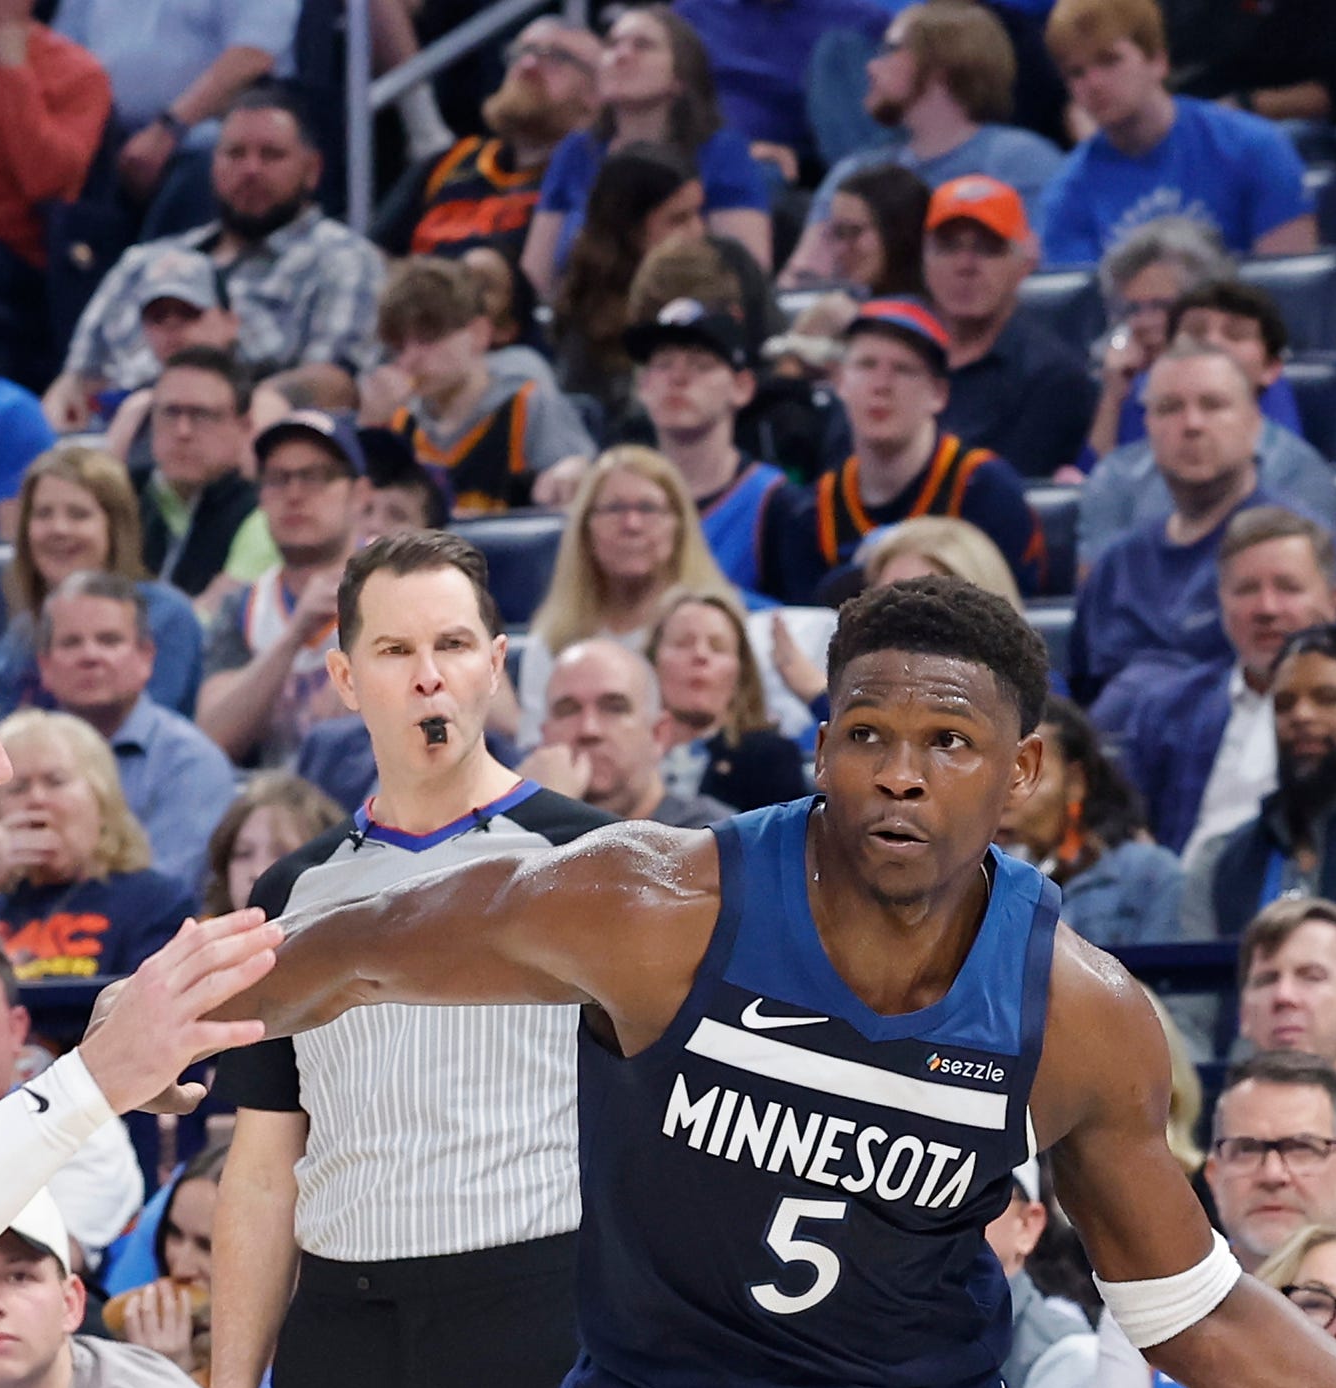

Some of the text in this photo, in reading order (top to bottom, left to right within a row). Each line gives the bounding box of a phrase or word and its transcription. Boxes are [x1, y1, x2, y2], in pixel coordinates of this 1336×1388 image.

[940, 1058, 1005, 1082] sezzle
[662, 1072, 977, 1208] MINNESOTA
[750, 1197, 847, 1315] 5
